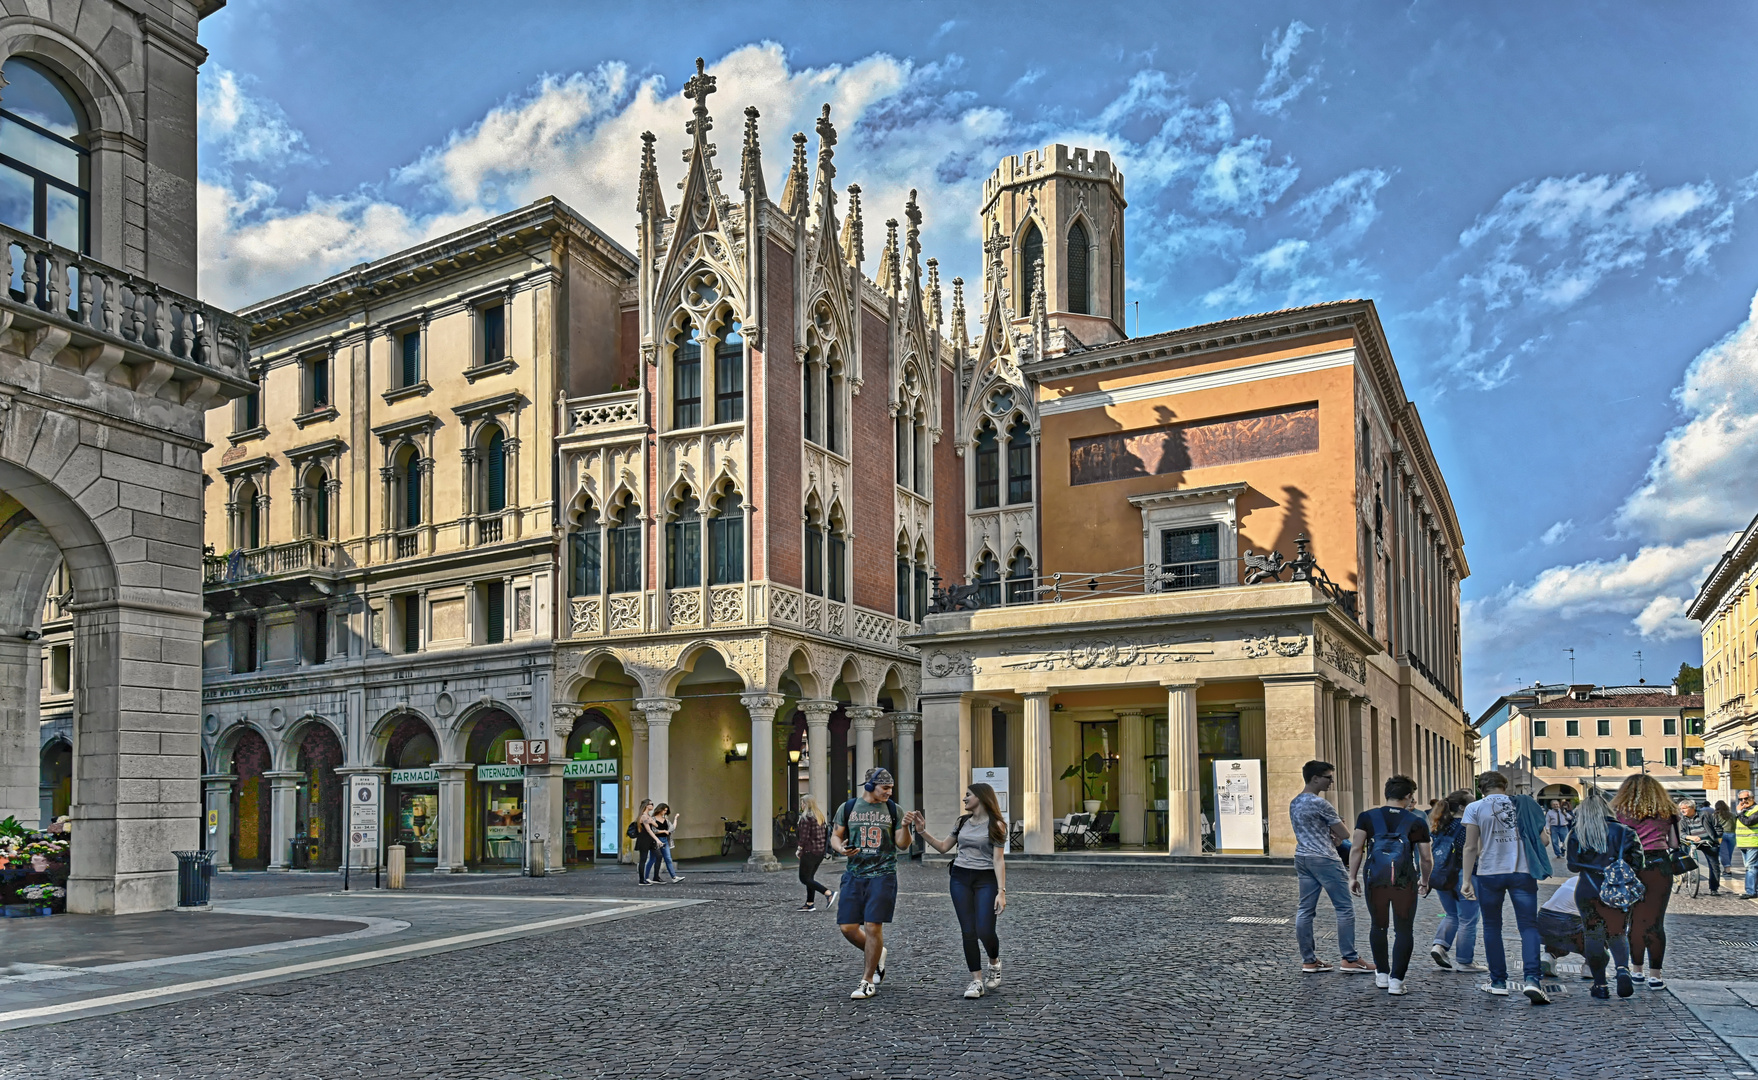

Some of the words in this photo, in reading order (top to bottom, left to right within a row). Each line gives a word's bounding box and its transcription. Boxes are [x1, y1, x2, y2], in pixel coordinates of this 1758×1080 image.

[563, 763, 616, 775] ARMACIA
[392, 770, 440, 782] FARMACIA
[849, 810, 893, 824] Ruthles
[859, 826, 882, 848] 19
